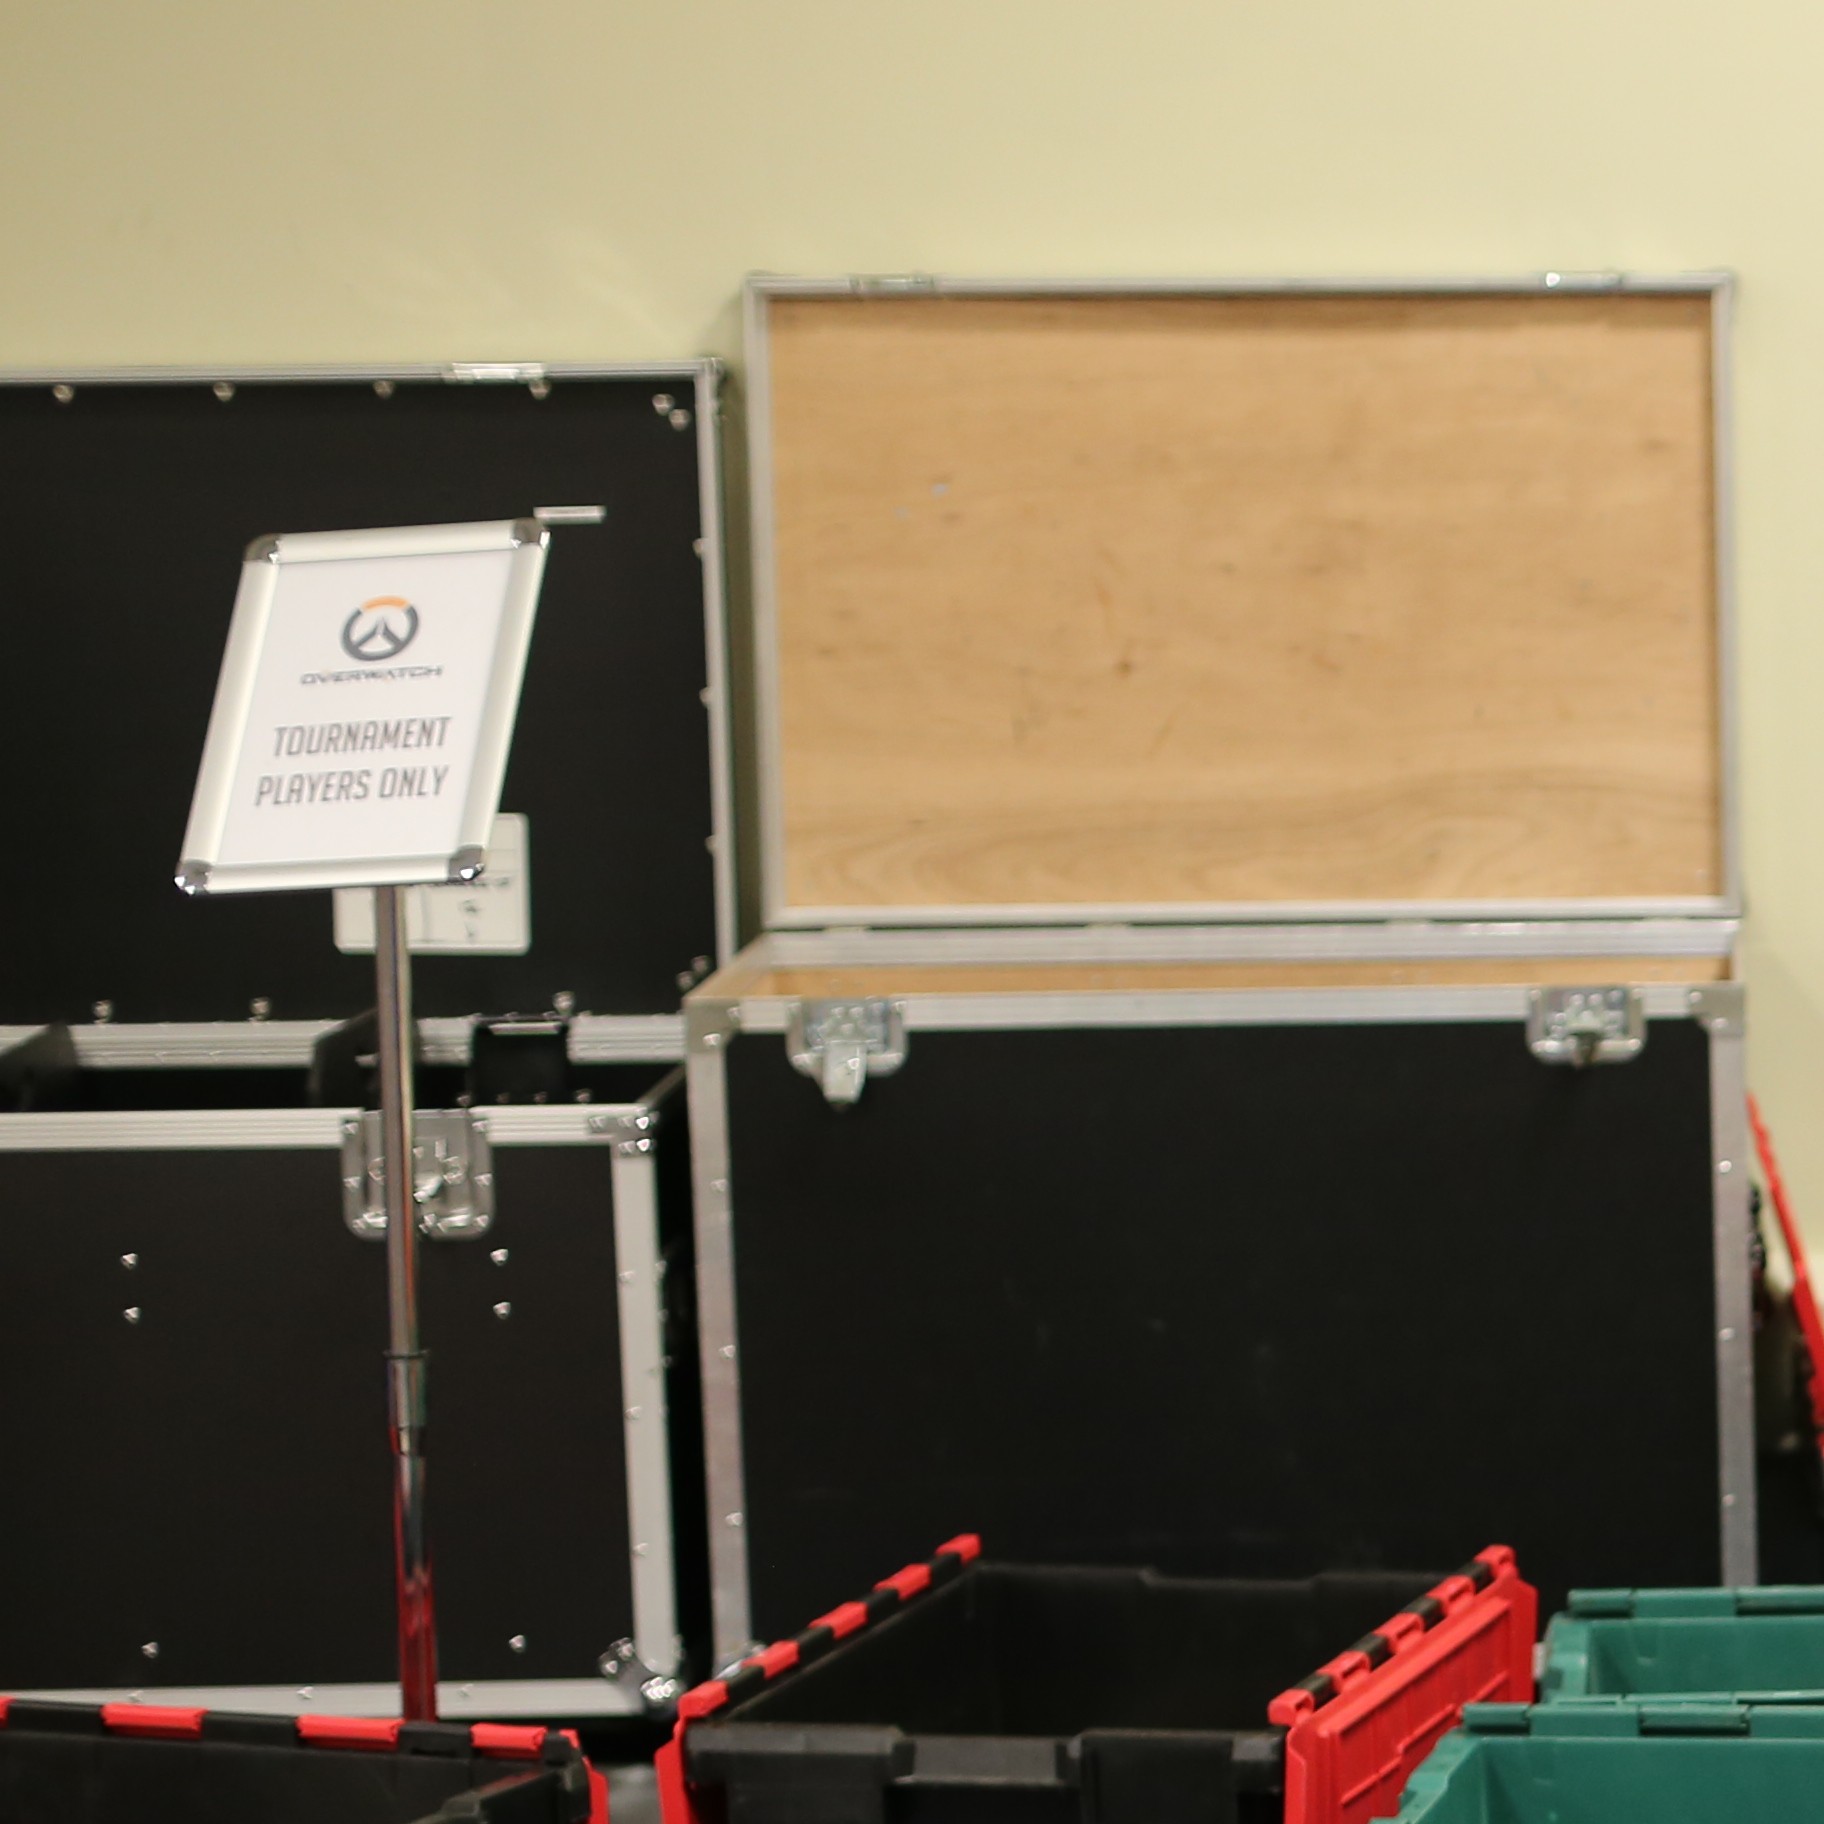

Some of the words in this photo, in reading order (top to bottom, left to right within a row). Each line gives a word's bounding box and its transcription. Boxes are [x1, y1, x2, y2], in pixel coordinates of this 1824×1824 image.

[301, 665, 443, 685] OVERWATCH
[273, 716, 452, 757] TOURNAMENT
[255, 770, 372, 807] PLAYERS
[377, 765, 449, 799] ONLY
